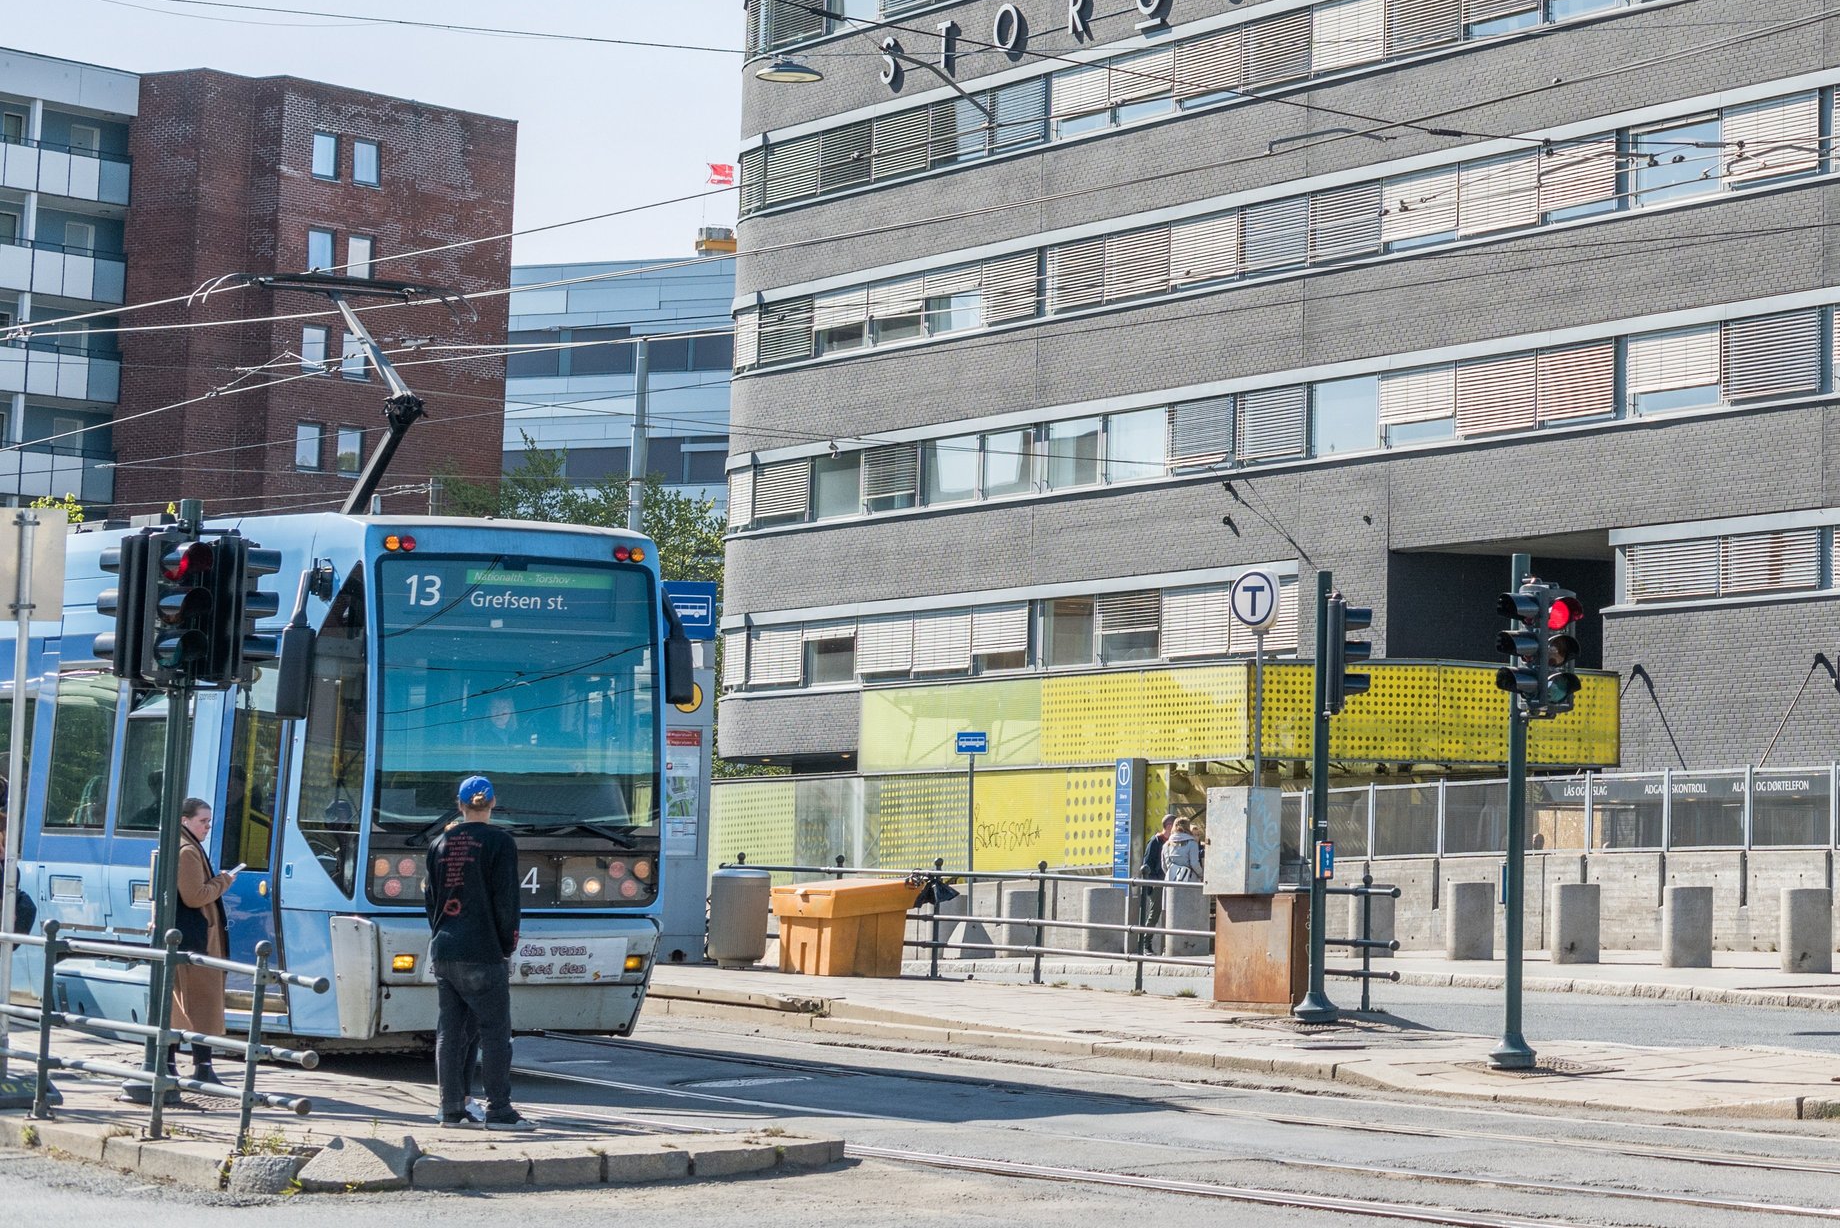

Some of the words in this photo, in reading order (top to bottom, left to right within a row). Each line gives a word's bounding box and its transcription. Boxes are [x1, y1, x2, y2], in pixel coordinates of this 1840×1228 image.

[535, 573, 570, 585] Torshov
[405, 574, 442, 606] 13
[470, 590, 541, 610] Grefsen
[547, 593, 568, 610] st.
[1242, 585, 1265, 617] T
[1563, 784, 1575, 796] LÅS
[1575, 785, 1585, 796] OG
[1592, 784, 1608, 796] SLAG
[1644, 782, 1707, 795] ADGASKONTROLL
[1755, 782, 1766, 792] OG
[1767, 780, 1809, 792] DØRTELEFON
[520, 866, 541, 894] 4
[520, 943, 546, 957] din
[549, 944, 594, 959] venn,
[559, 962, 588, 975] den
